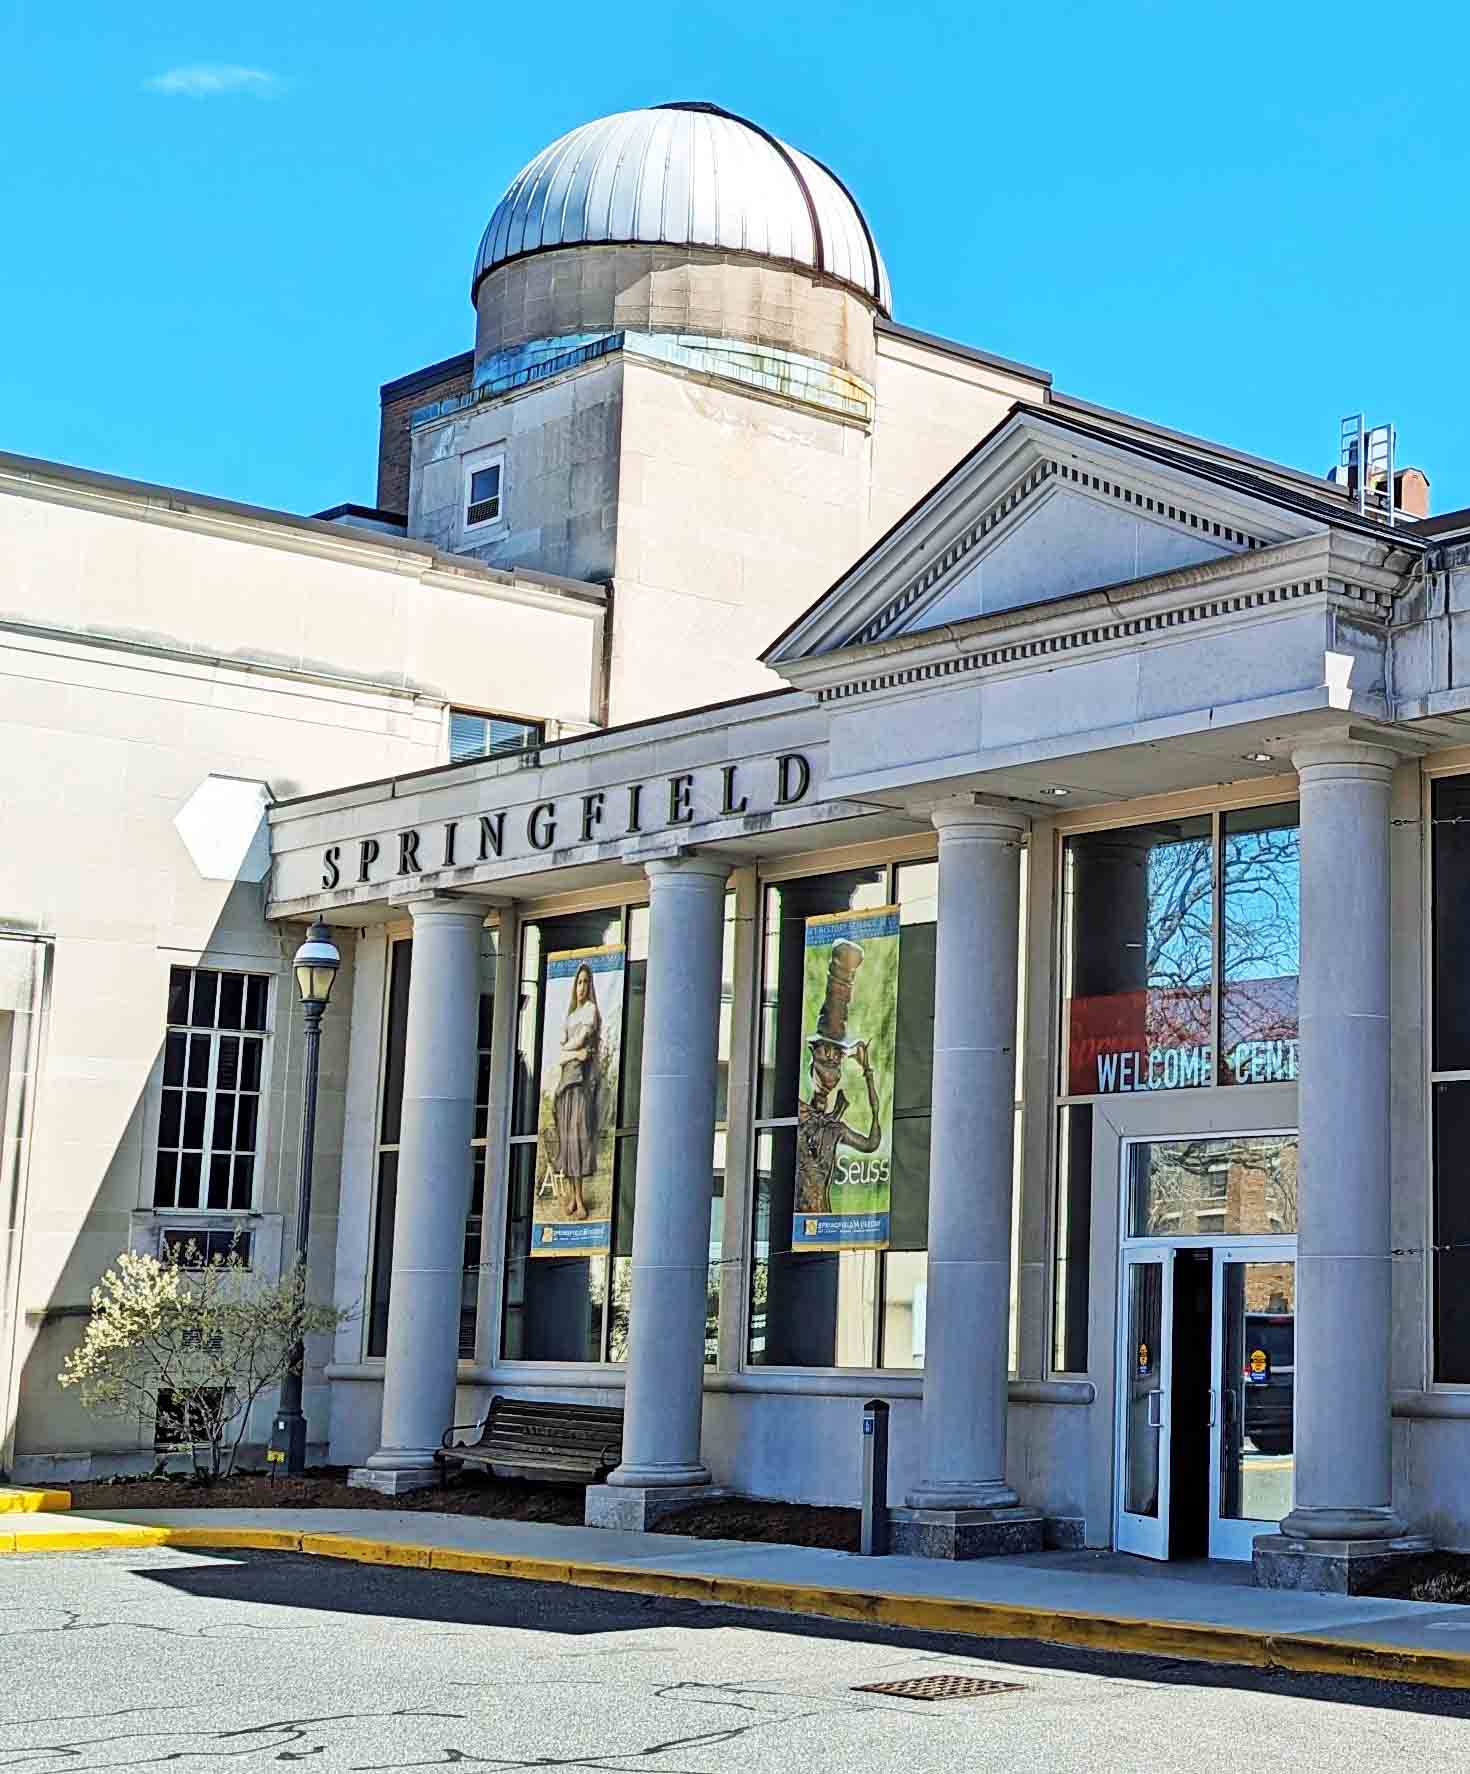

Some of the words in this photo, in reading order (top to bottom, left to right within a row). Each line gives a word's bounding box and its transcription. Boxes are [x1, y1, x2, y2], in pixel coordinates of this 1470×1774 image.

[322, 753, 811, 889] SPRINGFIELD
[1097, 1045, 1212, 1093] WELCOME
[538, 1162, 568, 1197] Art
[834, 1155, 889, 1185] Seuss
